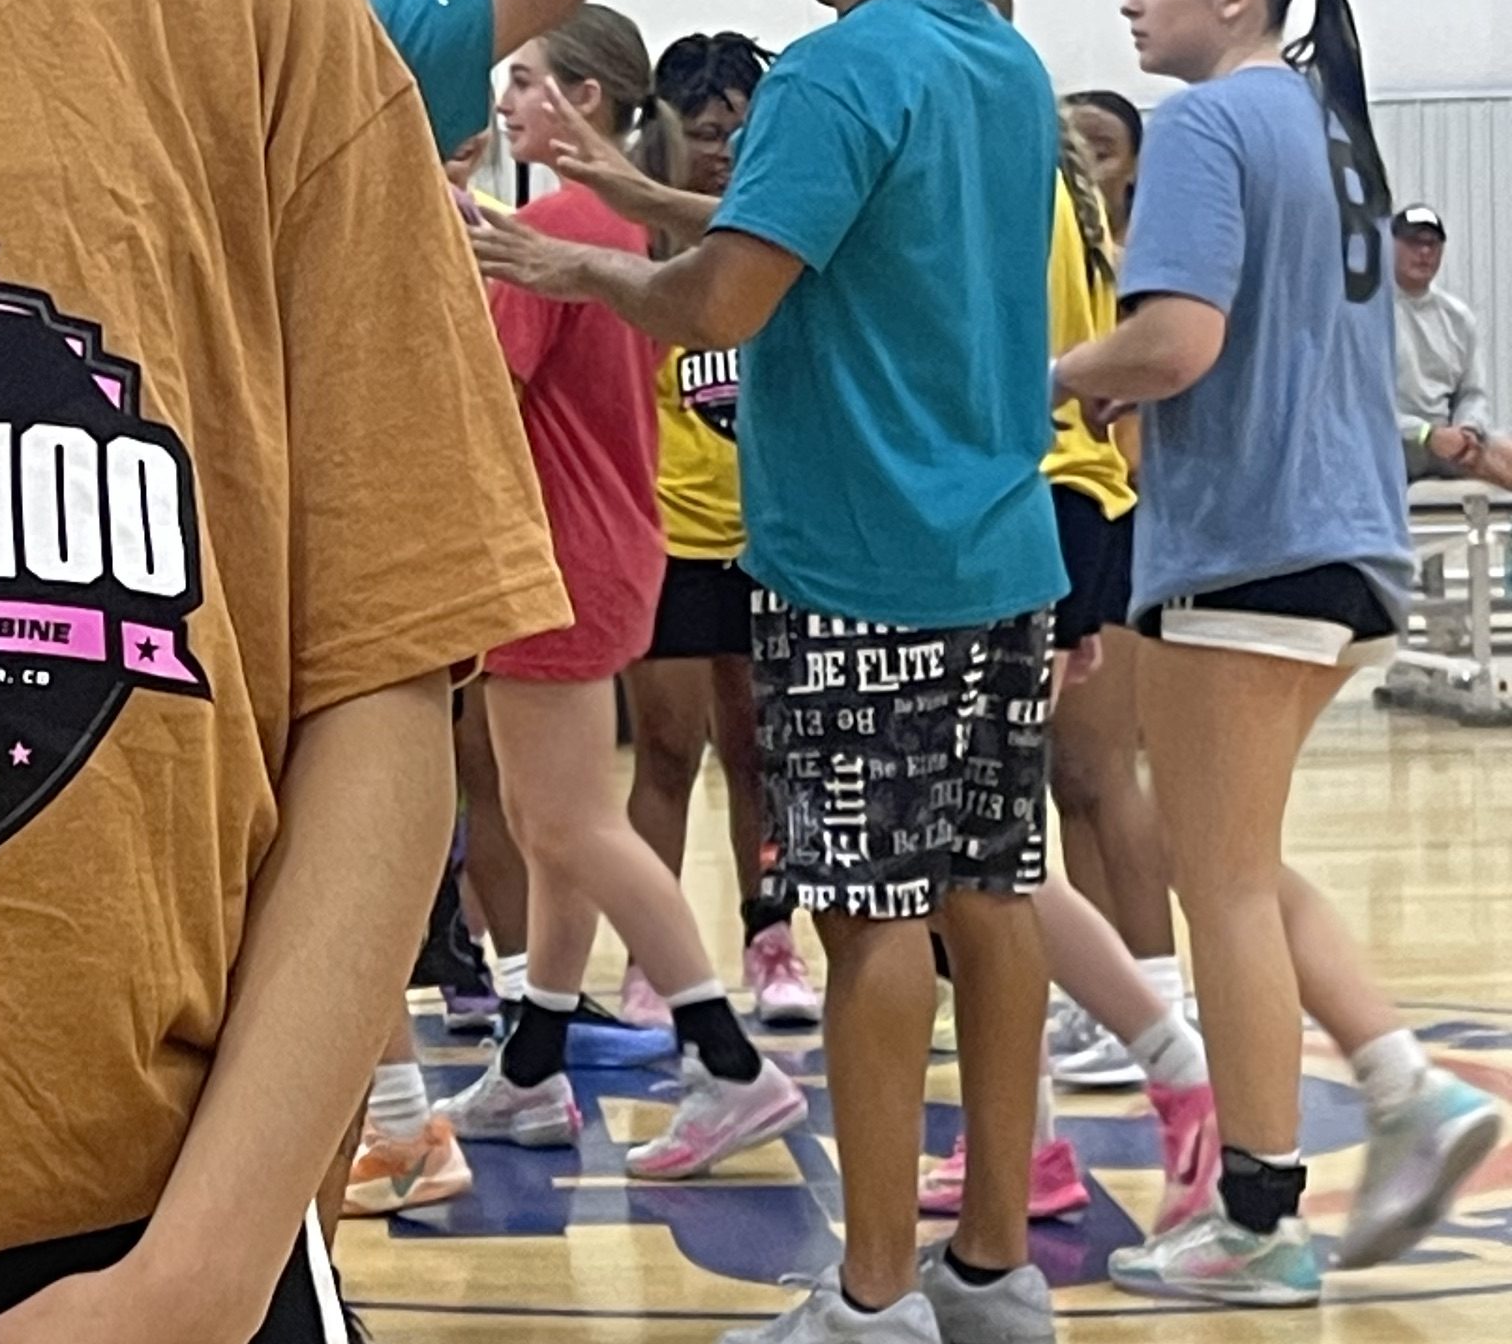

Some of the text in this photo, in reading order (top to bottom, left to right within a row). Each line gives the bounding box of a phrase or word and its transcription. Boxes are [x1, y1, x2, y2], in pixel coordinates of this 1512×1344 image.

[22, 670, 51, 686] CO
[787, 641, 945, 694] BE ELITE
